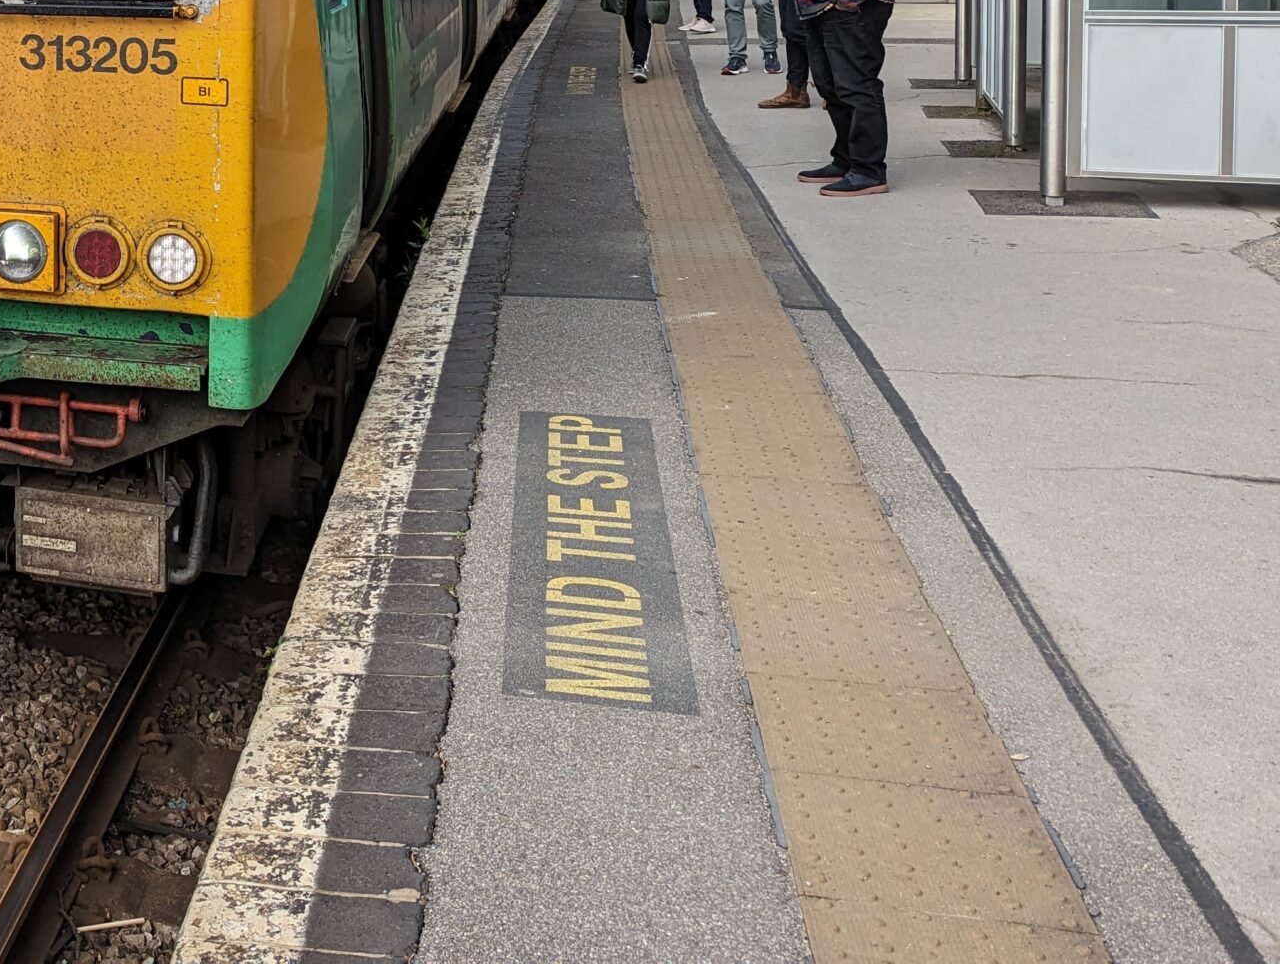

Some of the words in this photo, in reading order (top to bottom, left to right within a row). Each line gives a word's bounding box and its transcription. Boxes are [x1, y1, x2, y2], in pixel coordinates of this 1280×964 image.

[19, 33, 178, 75] 313205
[546, 414, 630, 490] STEP
[546, 495, 637, 562] THE
[545, 576, 652, 703] MIND
